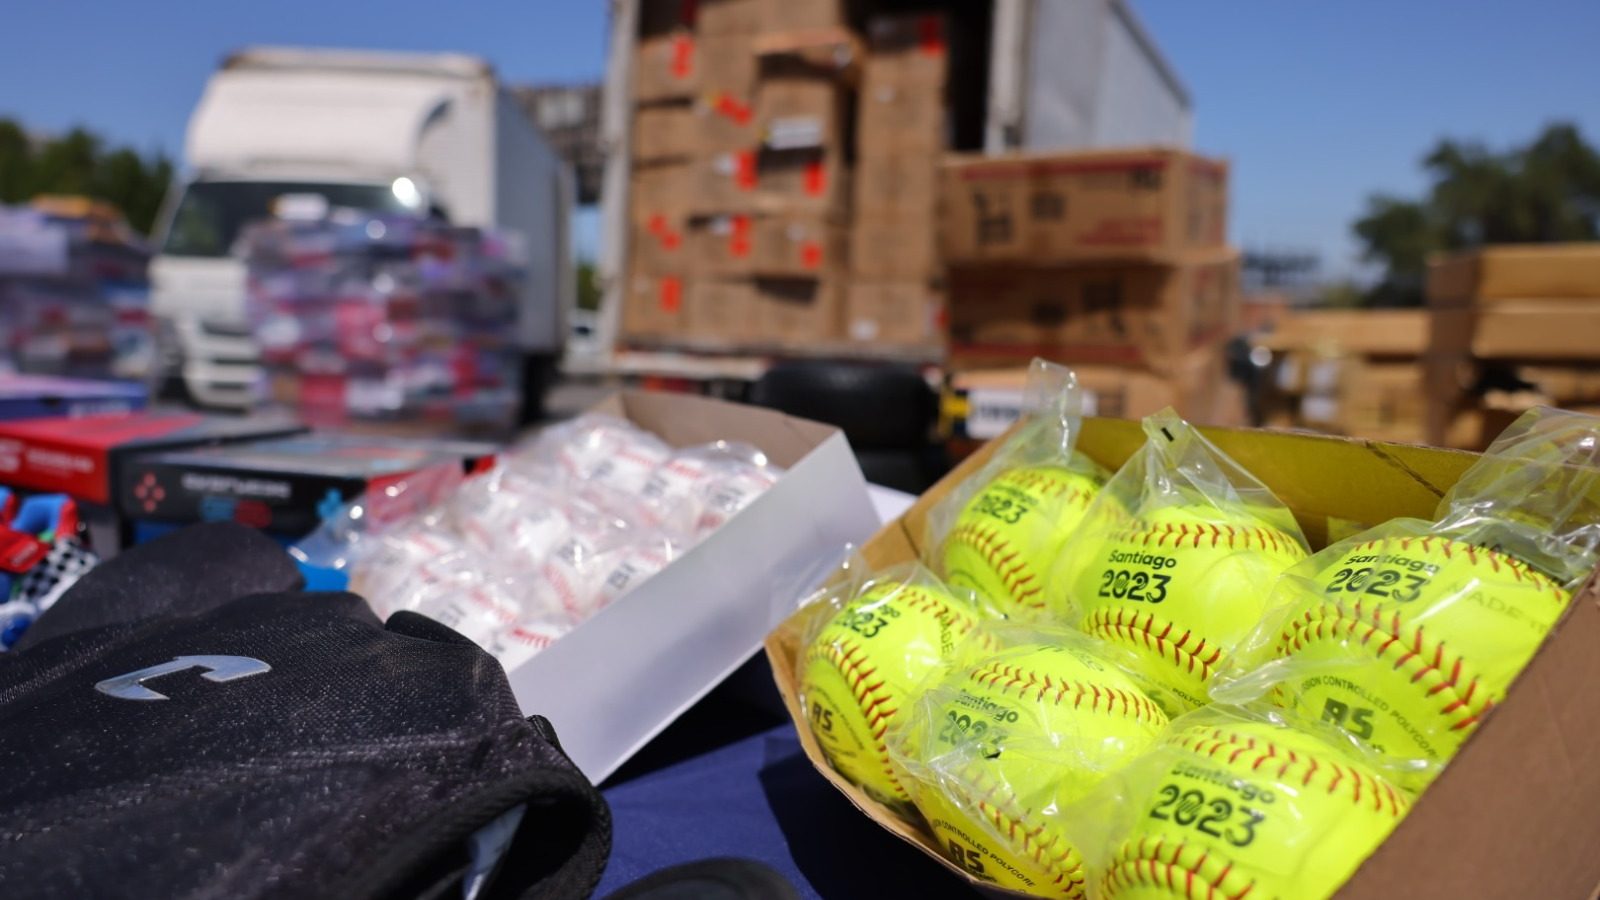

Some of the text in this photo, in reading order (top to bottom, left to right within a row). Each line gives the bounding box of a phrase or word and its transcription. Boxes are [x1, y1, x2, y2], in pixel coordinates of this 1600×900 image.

[1108, 549, 1177, 570] Santiago
[1098, 569, 1172, 604] 2023
[1325, 567, 1430, 602] 2023
[1321, 697, 1374, 740] RS
[1150, 784, 1265, 847] 2023
[990, 853, 1036, 888] POLYCORE
